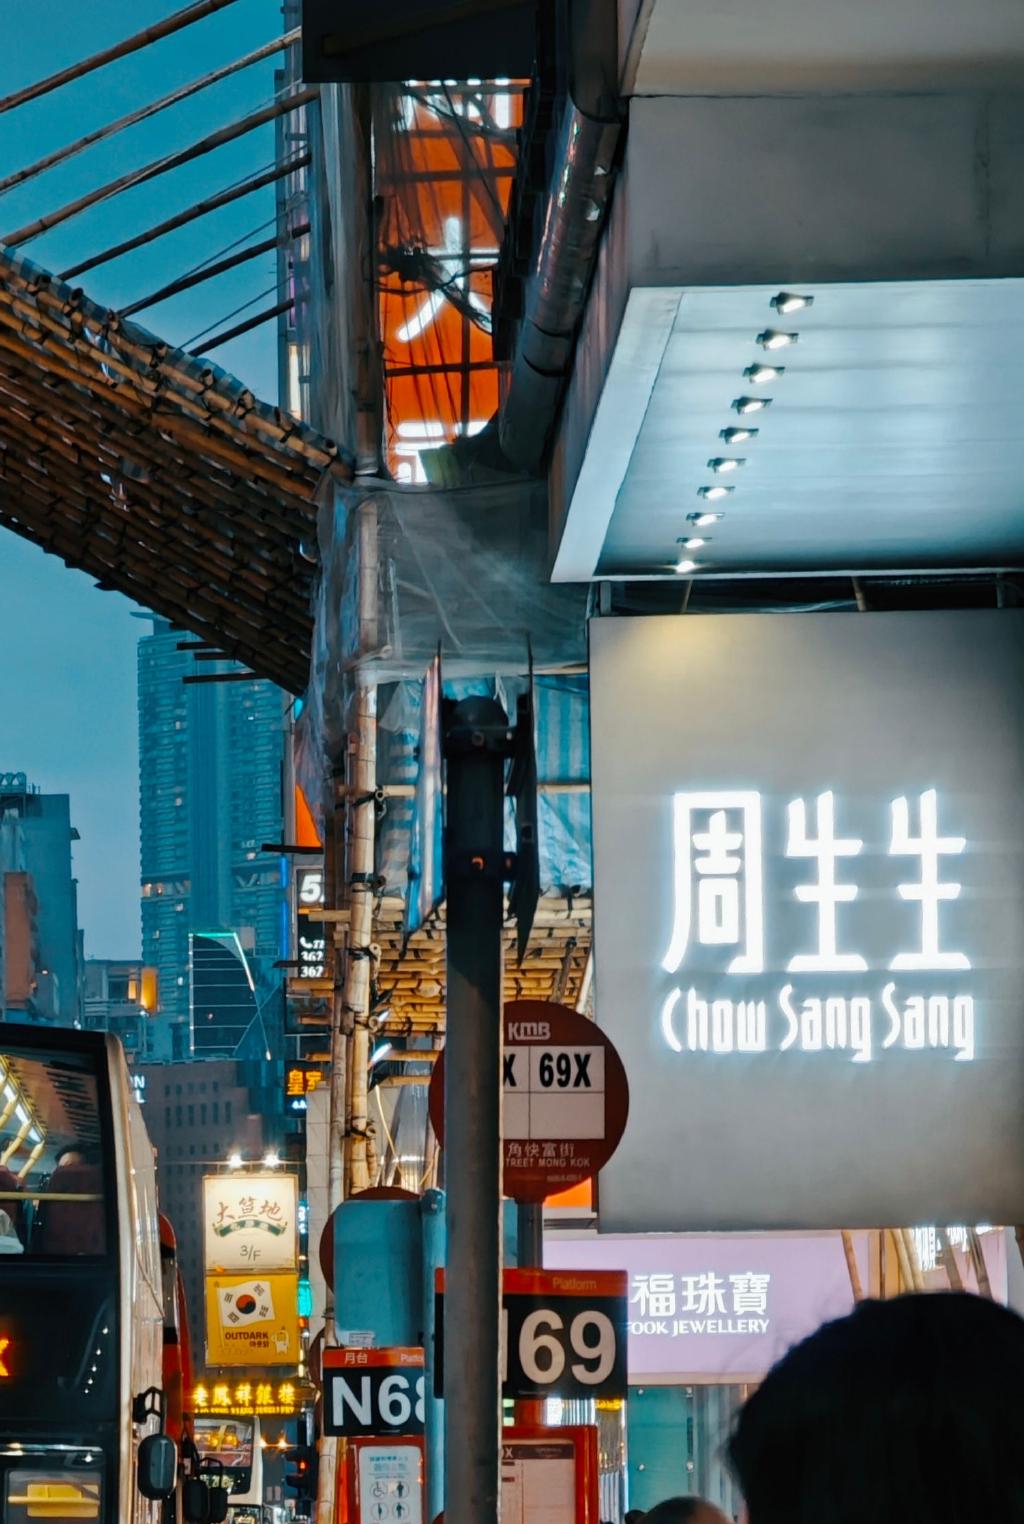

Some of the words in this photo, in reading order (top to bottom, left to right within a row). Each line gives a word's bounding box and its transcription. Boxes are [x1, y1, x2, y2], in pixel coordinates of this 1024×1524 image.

[663, 790, 972, 975] 周生生
[508, 1022, 551, 1041] KMB
[662, 988, 766, 1053] Chow
[780, 983, 872, 1063] Sang
[882, 982, 975, 1062] Sang
[539, 1053, 591, 1087] 69X
[538, 1158, 567, 1167] MONG
[570, 1158, 591, 1167] KOK
[239, 1244, 262, 1262] 3/F
[552, 1276, 597, 1290] Platform
[225, 1331, 269, 1340] OUTDARK
[672, 1319, 770, 1338] JEWELLERY
[344, 1352, 368, 1364] 月台
